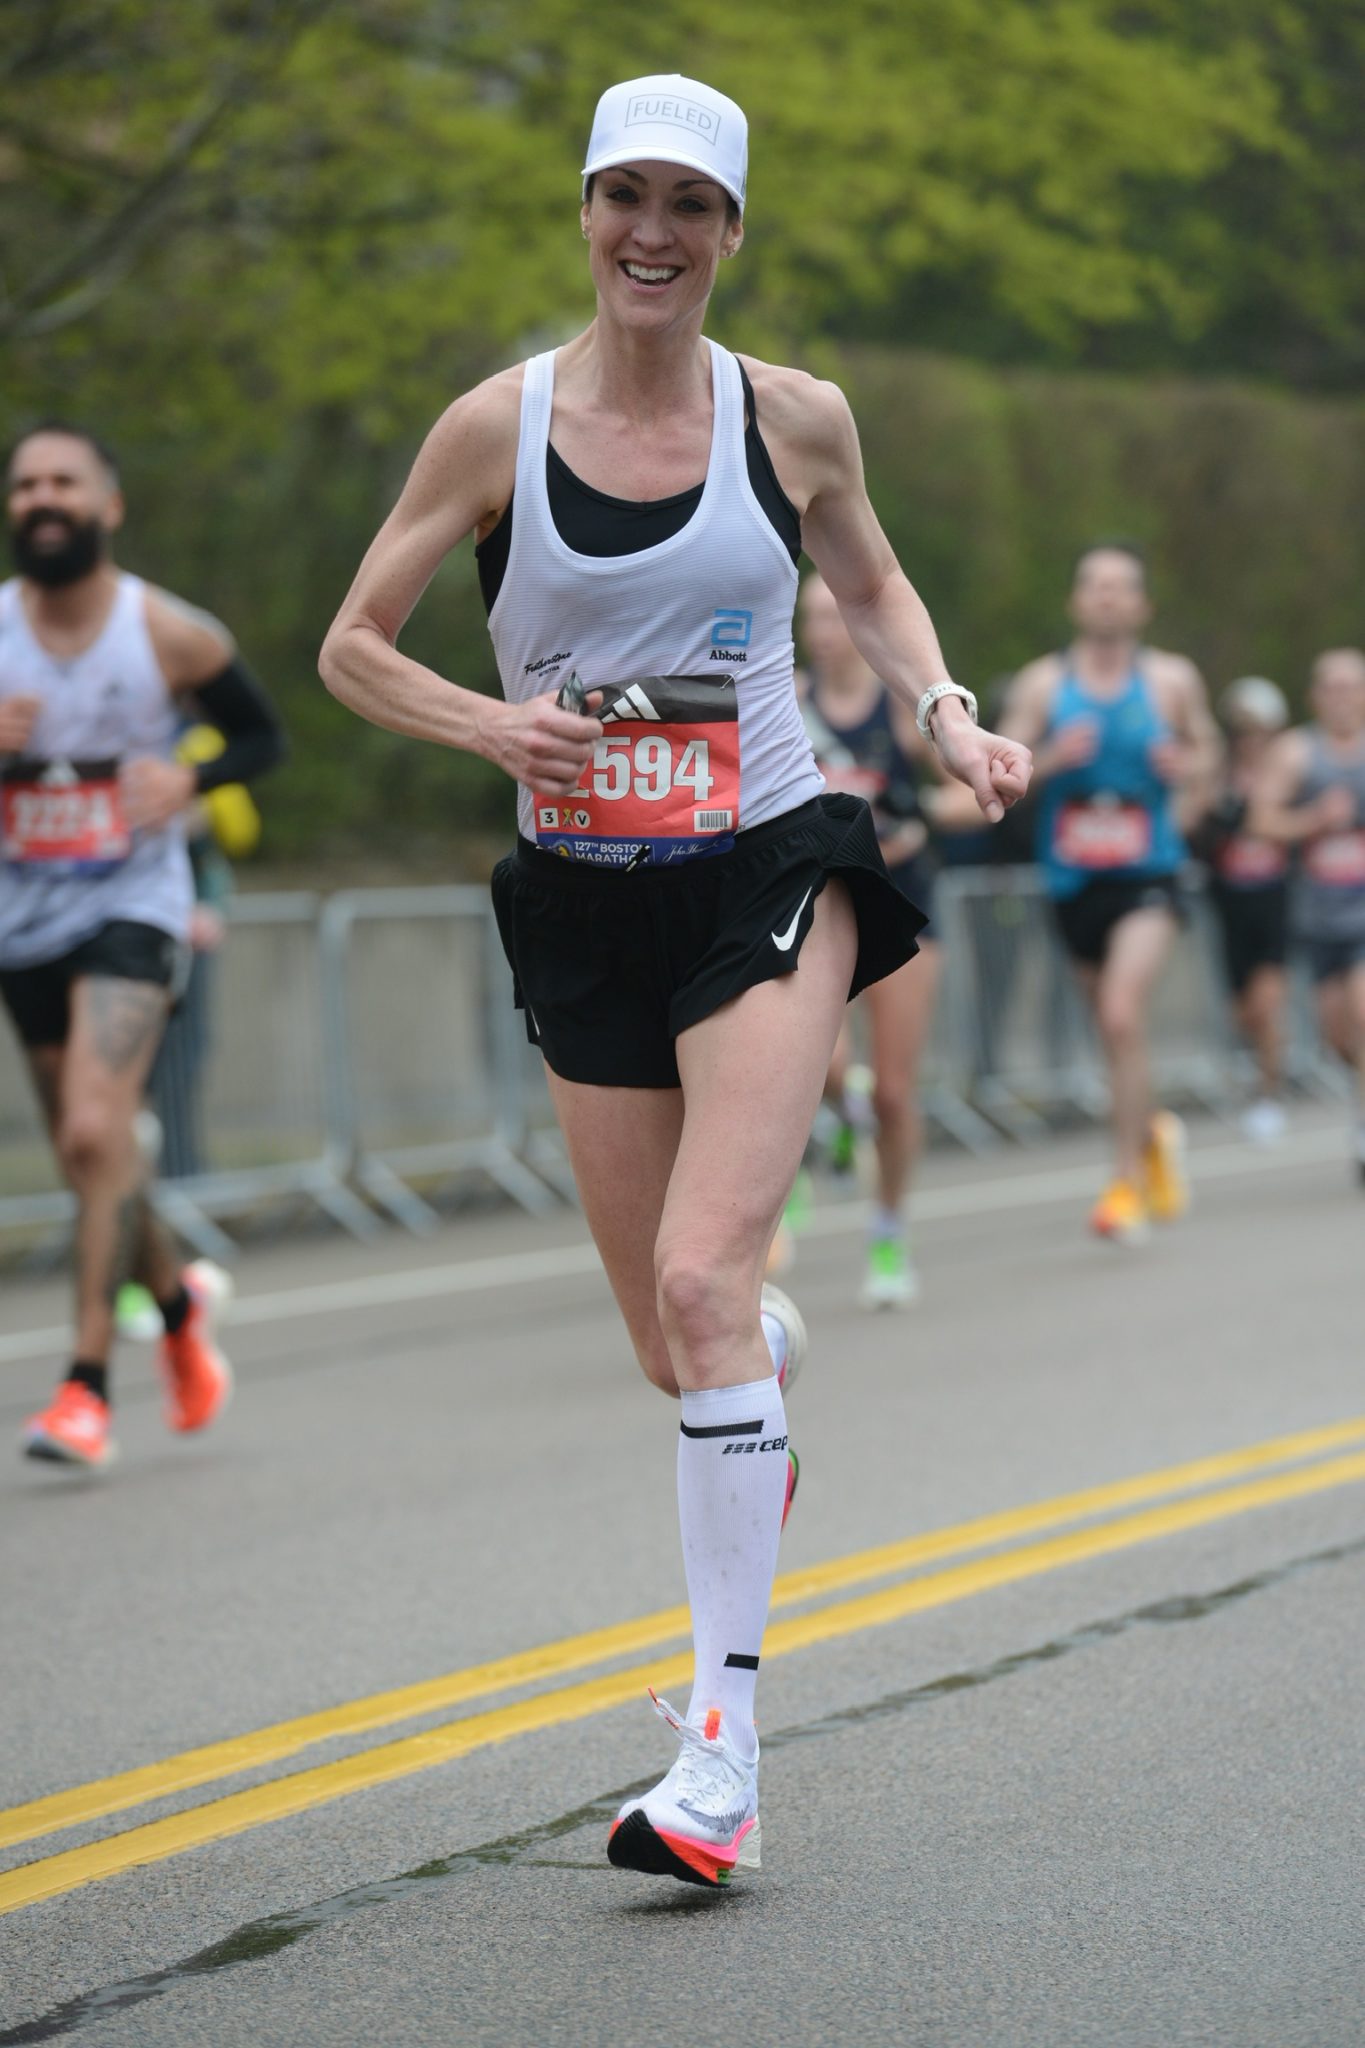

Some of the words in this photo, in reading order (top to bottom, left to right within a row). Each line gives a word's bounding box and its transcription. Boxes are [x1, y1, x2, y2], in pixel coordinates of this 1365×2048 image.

[633, 100, 712, 131] FUELED
[709, 650, 748, 662] Abbott
[567, 735, 714, 801] 594
[544, 812, 554, 824] 3
[577, 814, 587, 825] V
[574, 841, 599, 852] 127TH
[600, 843, 643, 854] BOSTO
[759, 1435, 788, 1453] cep
